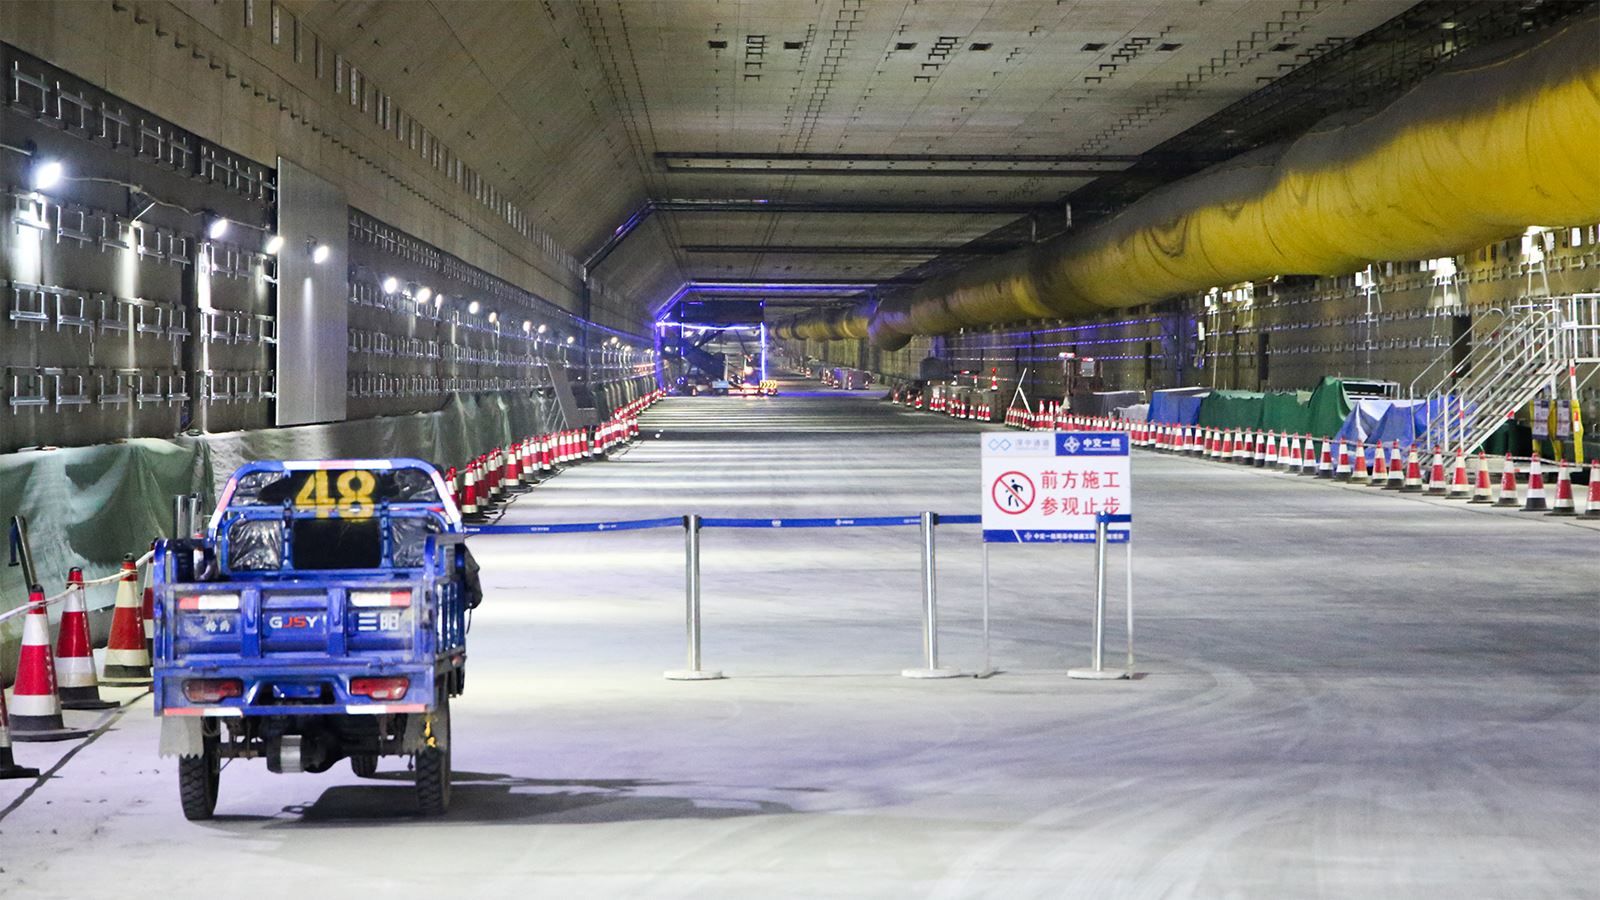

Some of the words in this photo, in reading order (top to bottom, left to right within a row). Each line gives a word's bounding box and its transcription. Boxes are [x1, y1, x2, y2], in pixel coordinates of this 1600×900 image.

[1040, 470, 1120, 490] 前方施工
[295, 470, 376, 523] 48
[1040, 496, 1121, 516] 参观止步
[269, 615, 318, 629] GJSY
